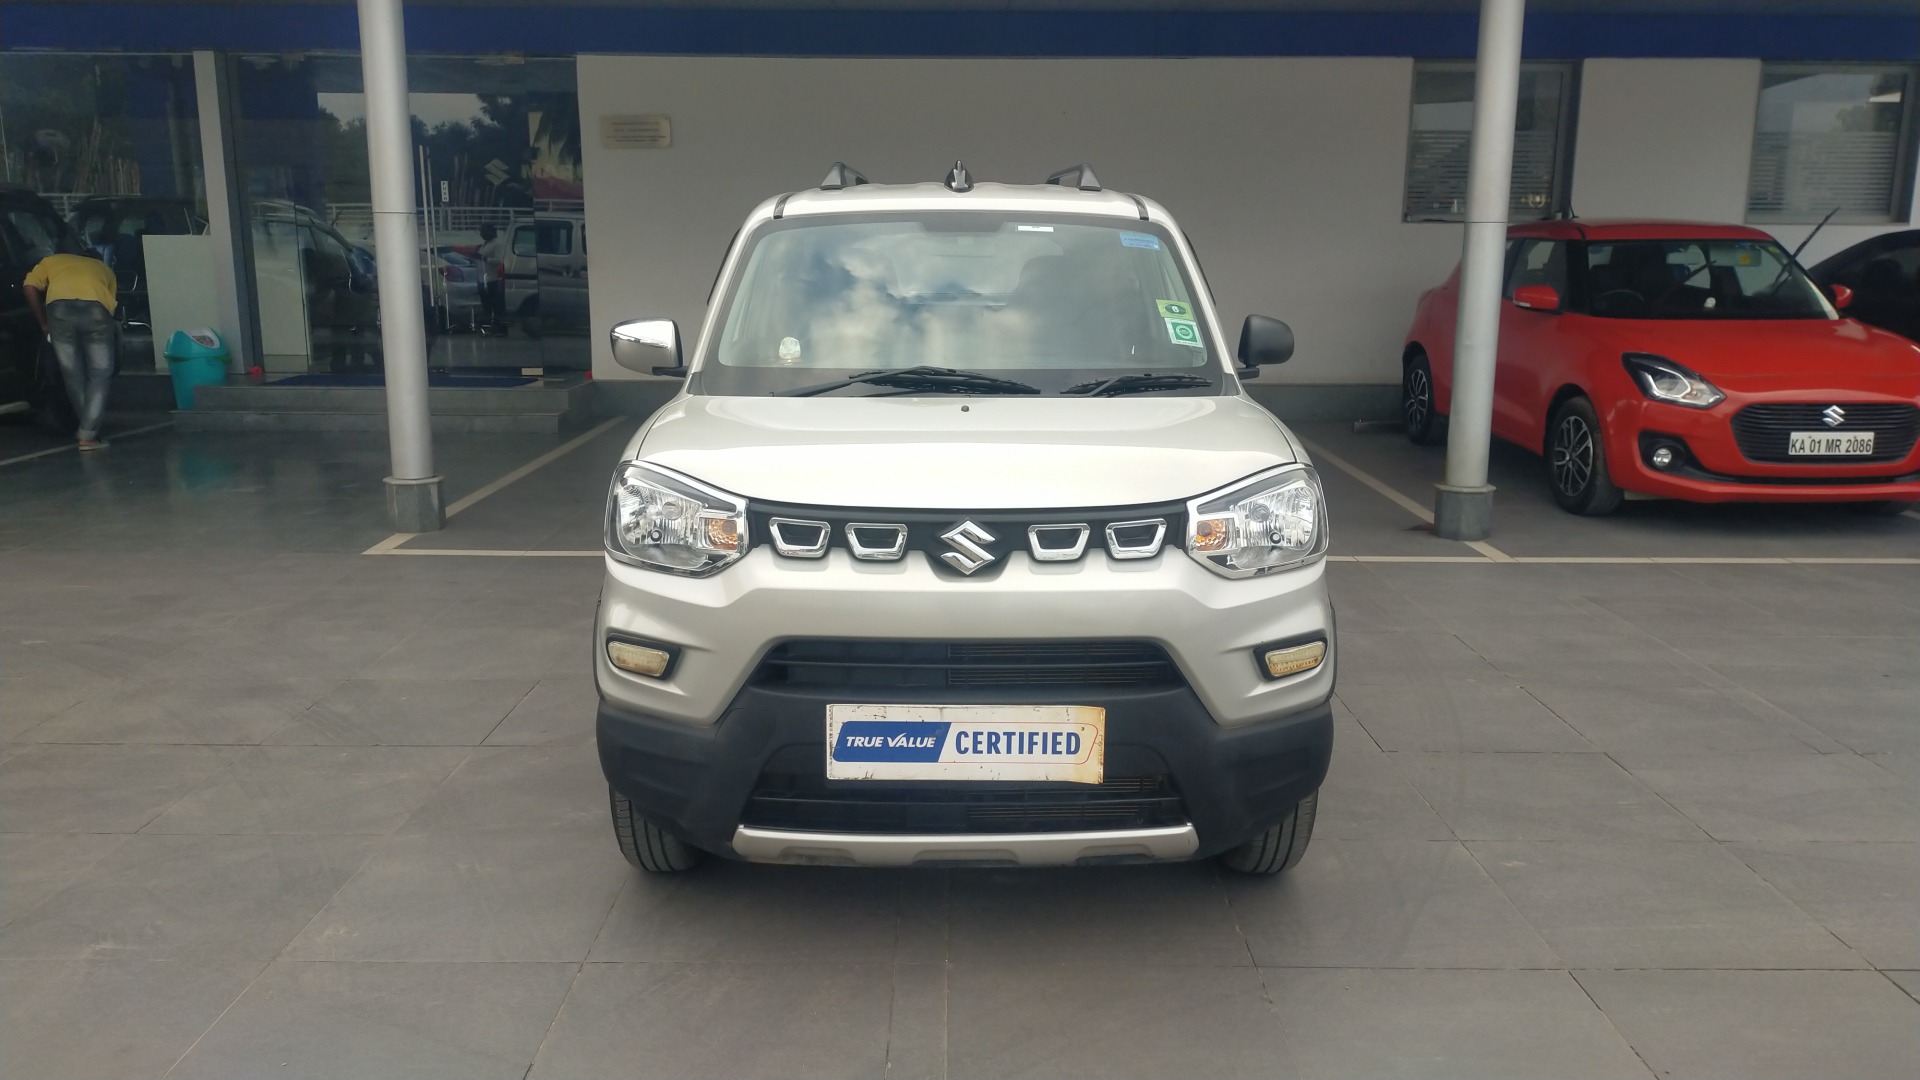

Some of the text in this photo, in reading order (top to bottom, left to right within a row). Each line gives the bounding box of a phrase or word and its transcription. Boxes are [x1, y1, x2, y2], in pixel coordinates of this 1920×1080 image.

[1790, 438, 1872, 453] KA 01 MR 2086
[846, 730, 1081, 755] TRUE VALUE CERTIFIED
